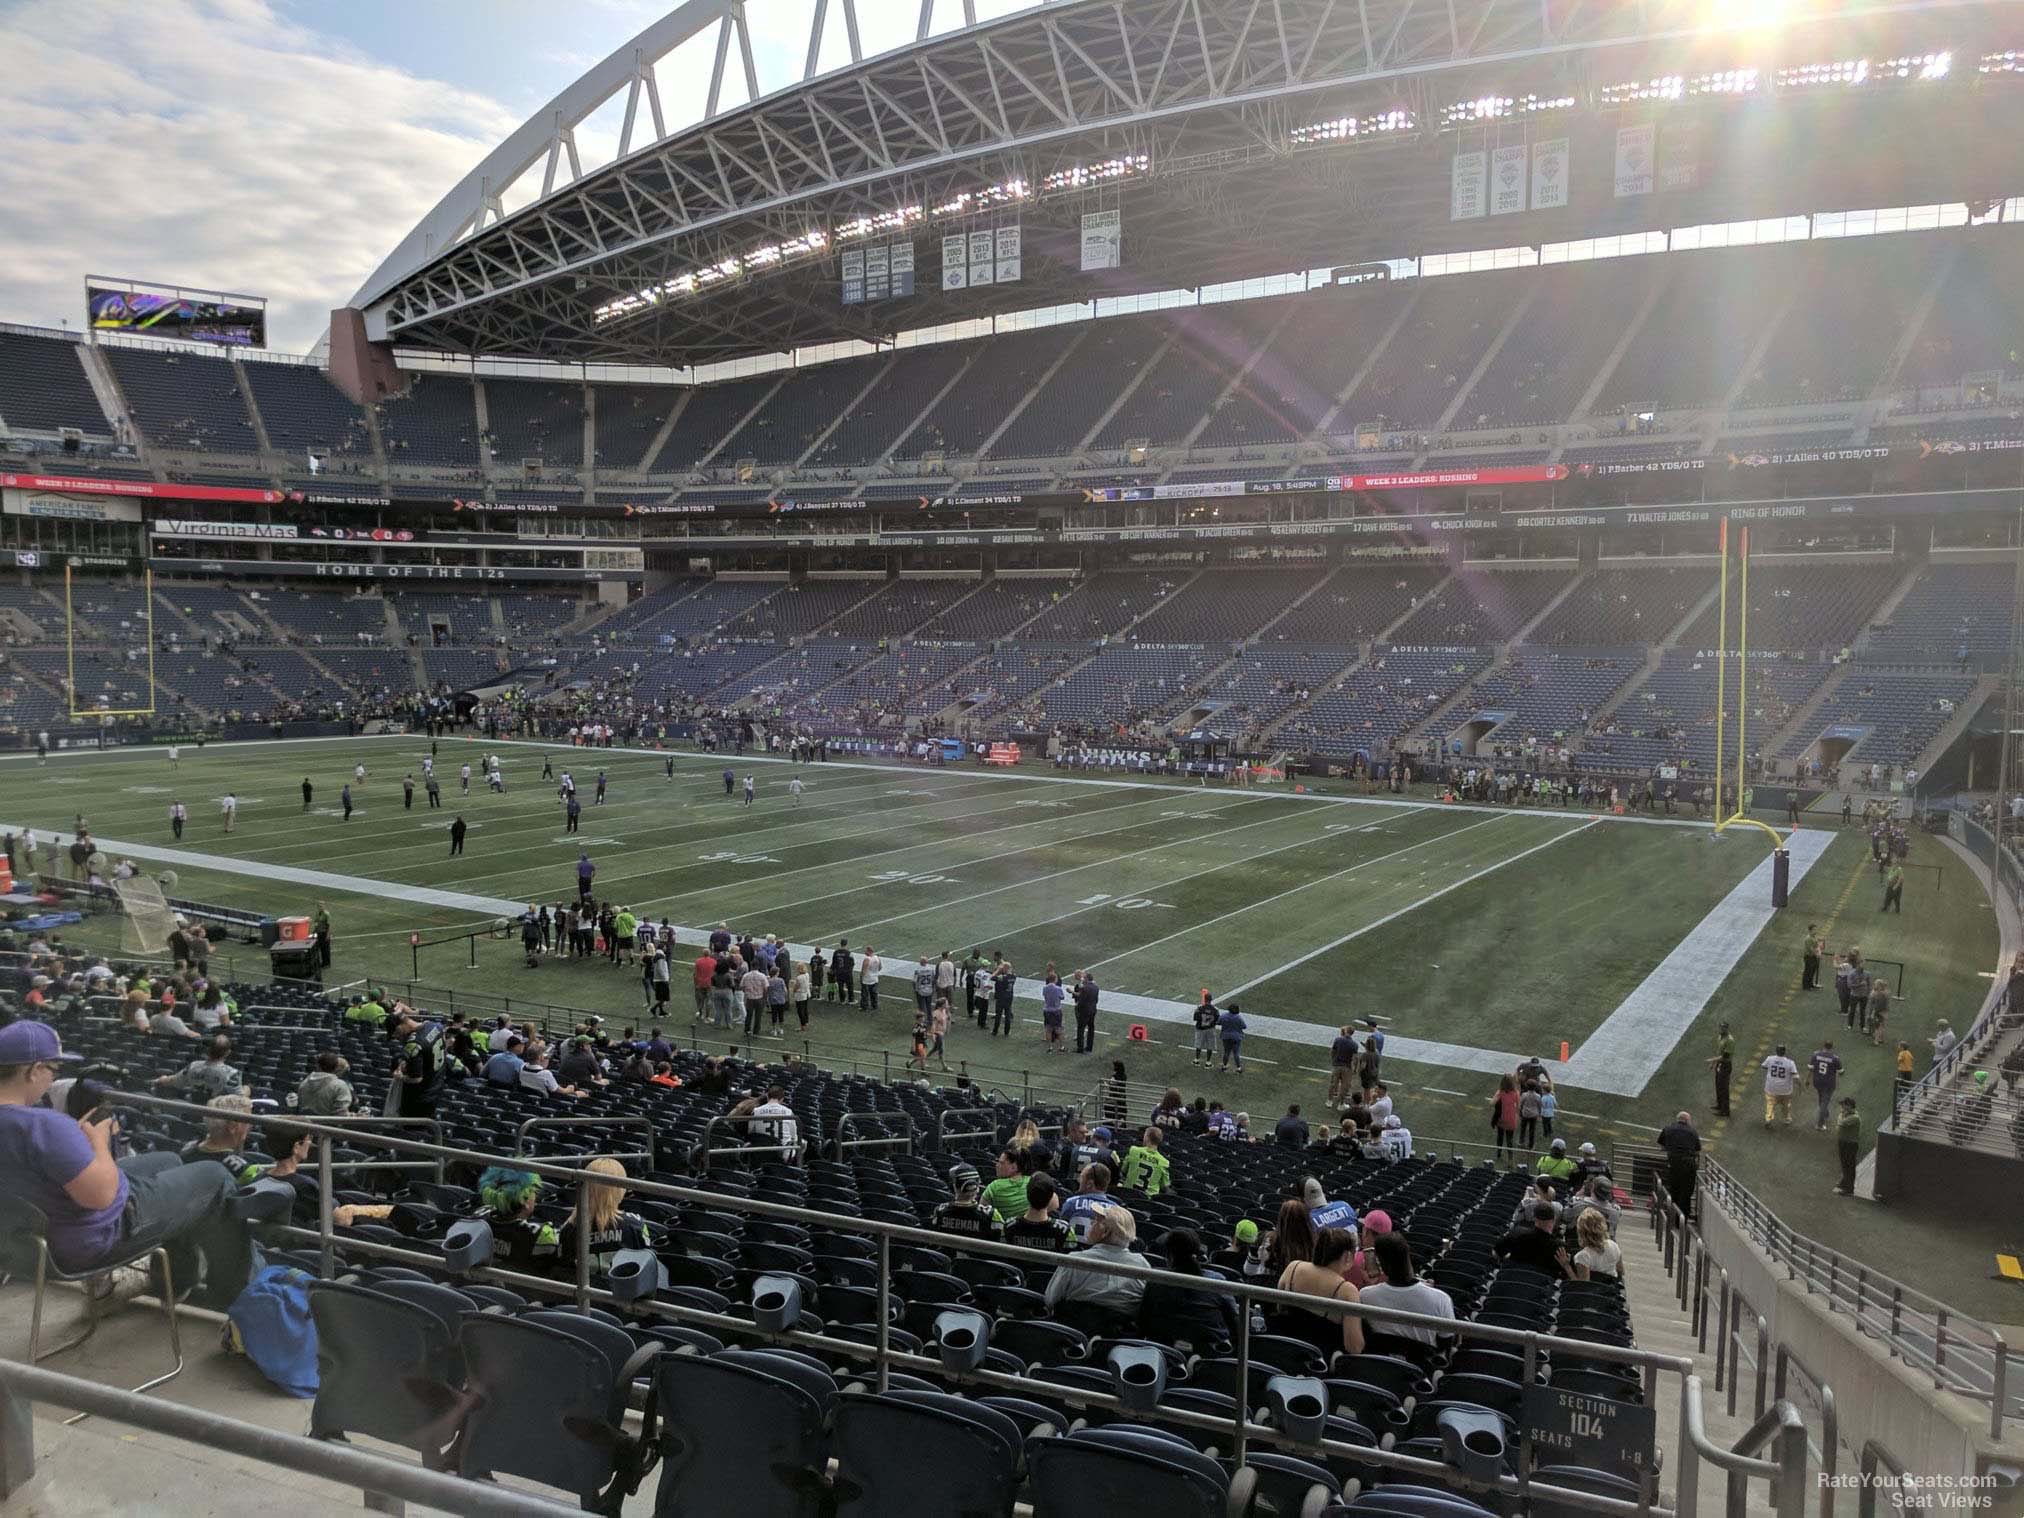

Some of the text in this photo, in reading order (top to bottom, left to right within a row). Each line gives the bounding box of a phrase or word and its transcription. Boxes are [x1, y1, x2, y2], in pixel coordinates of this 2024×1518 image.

[1785, 453, 1819, 463] J.Allen
[1822, 451, 1836, 461] 40
[1873, 448, 1889, 457] TD
[1691, 459, 1705, 468] TD
[1365, 478, 1390, 486] WEEK
[1626, 512, 1638, 522] 71
[1638, 512, 1667, 522] WALTER
[1668, 511, 1691, 521] JONES
[1730, 505, 1806, 519] RING OF HONOR
[316, 564, 505, 579] HOME OF THE 12s
[1132, 1026, 1144, 1040] G
[1770, 1065, 1786, 1078] 22
[1132, 1162, 1154, 1191] 3
[941, 1216, 980, 1233] SHERMAN
[1312, 1206, 1349, 1229] LARGENT
[589, 1229, 623, 1245] ERMAN
[494, 1238, 512, 1257] SON
[1558, 1393, 1617, 1417] SECTION
[1570, 1412, 1604, 1441] 104
[1530, 1428, 1572, 1448] SEATS
